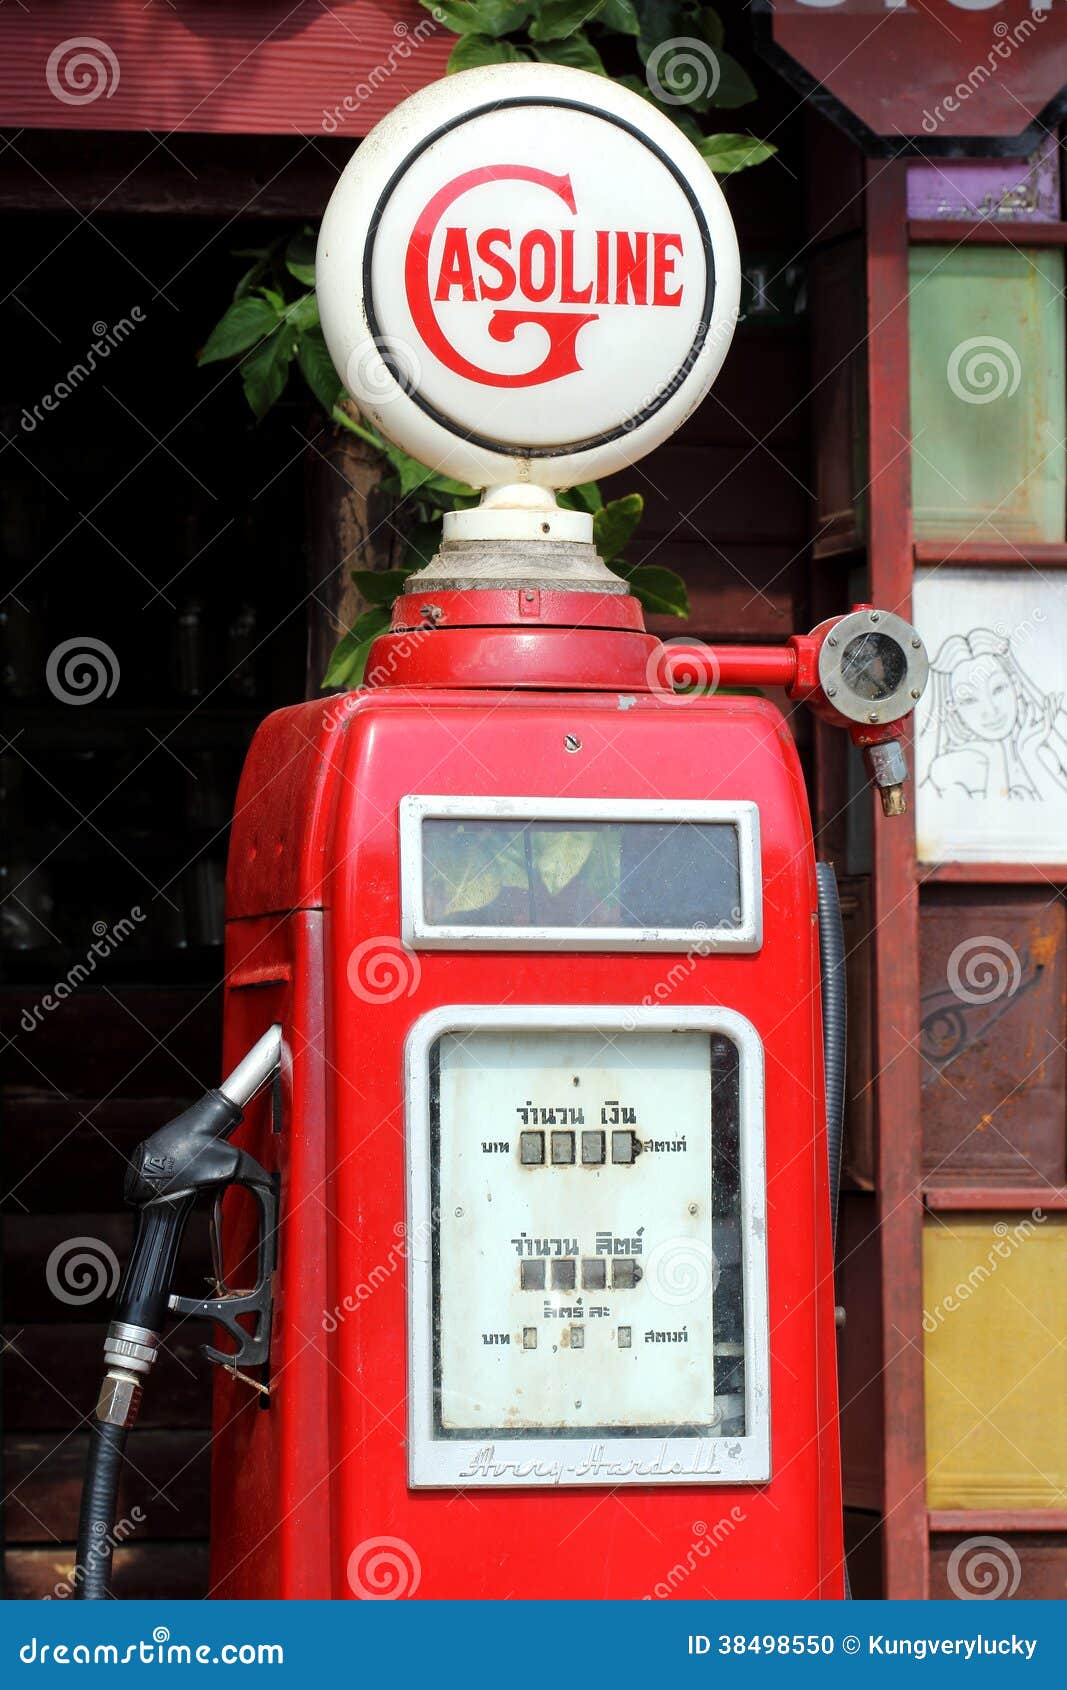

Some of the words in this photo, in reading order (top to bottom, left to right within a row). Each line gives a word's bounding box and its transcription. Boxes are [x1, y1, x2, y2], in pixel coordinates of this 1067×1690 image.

[405, 164, 684, 388] GASOLINE
[516, 1101, 584, 1125] จำนวน
[600, 1101, 637, 1125] เงิน
[481, 1141, 510, 1153] บาท
[643, 1135, 687, 1153] สตางค์
[511, 1232, 579, 1256] จำนวน
[481, 1333, 510, 1345] บาท
[644, 1325, 689, 1344] สตางค์
